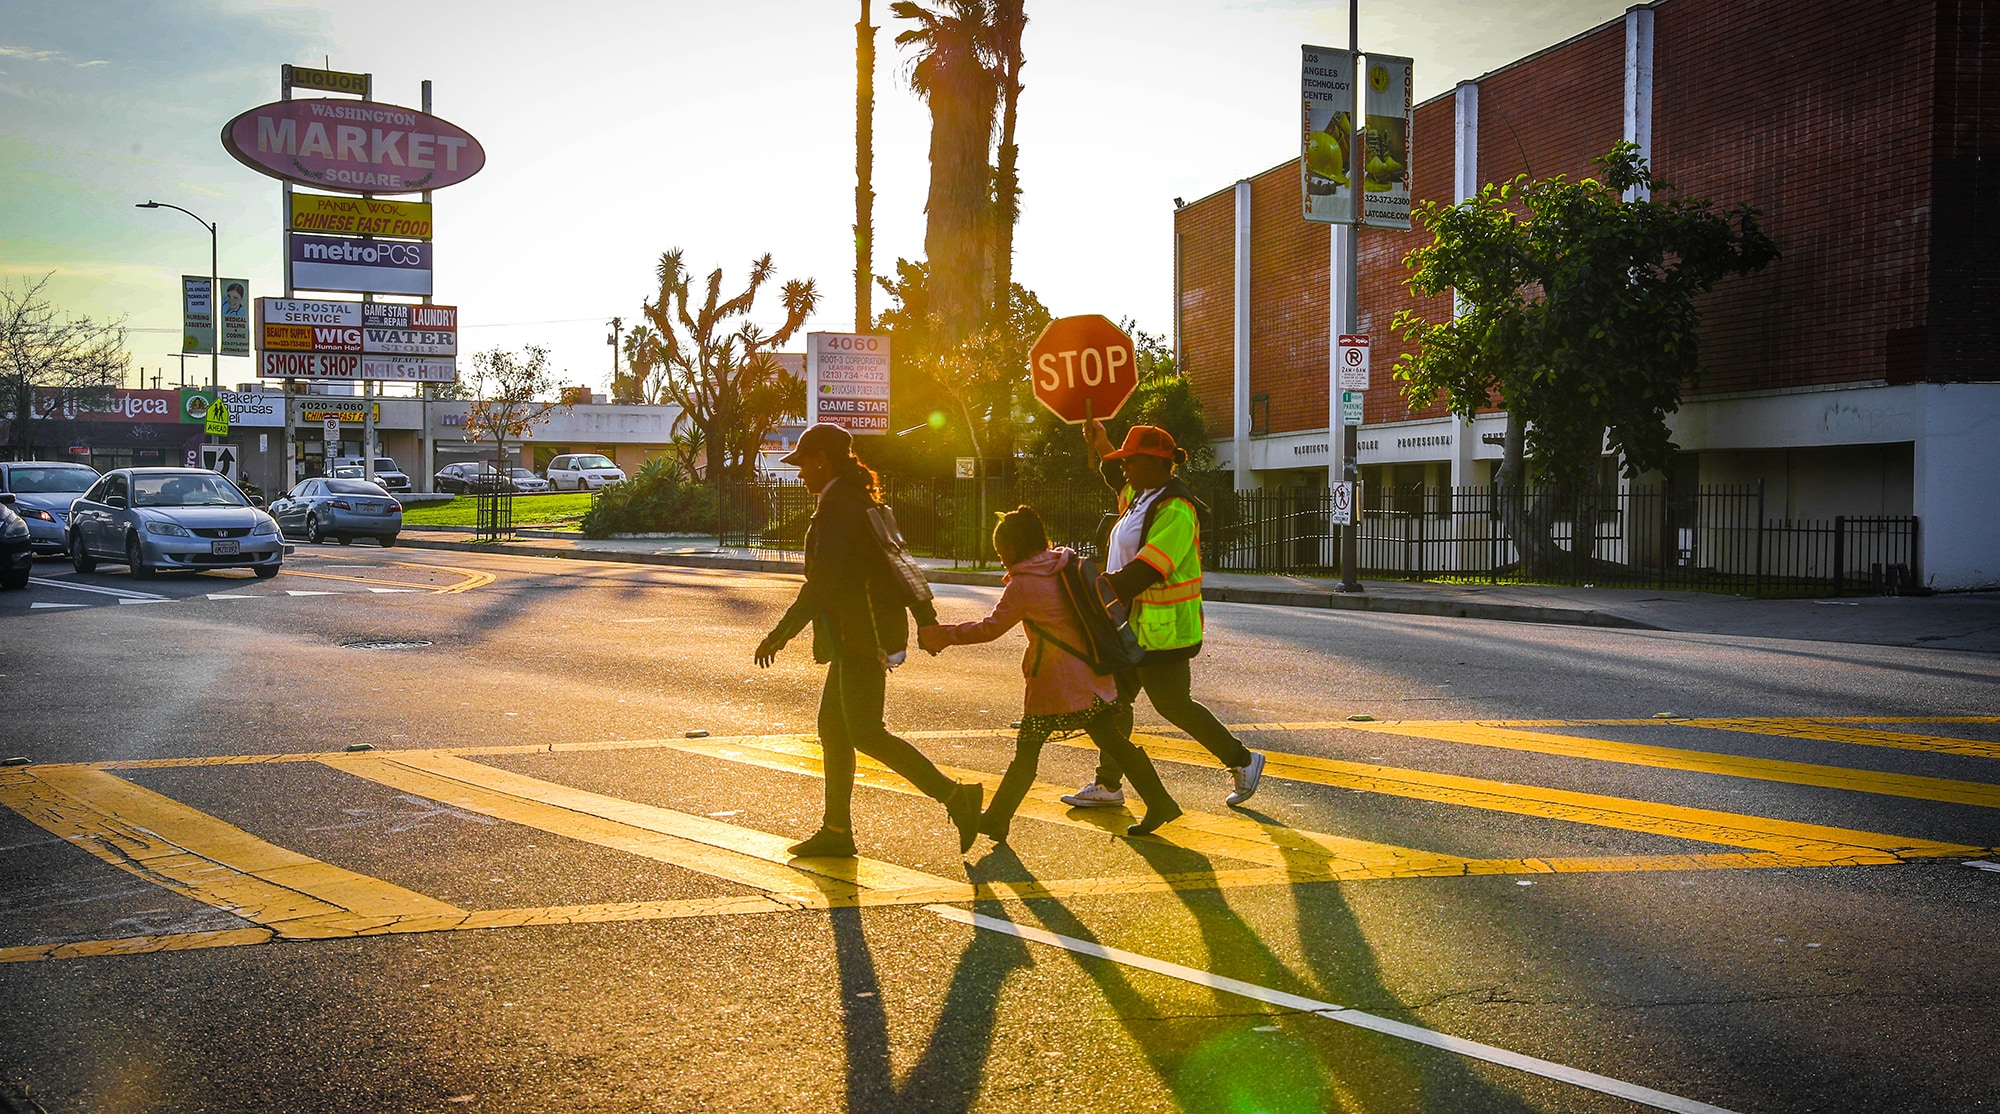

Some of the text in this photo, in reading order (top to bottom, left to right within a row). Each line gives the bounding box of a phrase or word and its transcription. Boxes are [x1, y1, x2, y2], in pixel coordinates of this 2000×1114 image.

[1304, 54, 1319, 63] LOS
[1304, 66, 1338, 78] ANGELES
[295, 70, 364, 90] LIQUOR
[1304, 78, 1350, 91] TECHNOLOGY
[1303, 90, 1333, 101] CENTER
[310, 103, 416, 127] WASHINGTON
[1403, 66, 1411, 192] CONSTRUCTION
[257, 116, 468, 172] MARKET
[1304, 101, 1312, 214] ELECTRICIAN
[325, 168, 401, 187] SQUARE
[1364, 194, 1410, 206] 323-373-2300
[317, 200, 408, 217] PANDA WOK
[294, 212, 430, 236] CHINESE FAST FOOD
[304, 241, 420, 266] metroPCS
[275, 302, 351, 314] U.S. POSTAL
[364, 304, 408, 318] GAME STAR
[285, 312, 341, 323] SERVICE
[384, 317, 408, 327] REPAIR
[413, 308, 456, 327] LAUNDRY
[267, 327, 311, 339] BEAUTY SUPPLY
[314, 327, 361, 345] WIG
[366, 329, 455, 346] WATER
[381, 344, 439, 352] STORE
[828, 337, 878, 351] 4060
[266, 353, 358, 377] SMOKE SHOP
[845, 356, 887, 366] CORPORATION
[364, 363, 456, 380] NAILS & HAIR
[1038, 345, 1128, 391] STOP
[822, 371, 884, 381] (213) 734-4372
[221, 392, 265, 405] Bakery
[300, 402, 328, 410] 4020
[819, 400, 888, 412] GAME STAR
[229, 412, 240, 423] eli
[339, 412, 358, 420] FAST
[851, 417, 888, 428] REPAIR
[207, 424, 227, 433] AHEAD
[1294, 443, 1329, 455] WASHINGTO
[1358, 440, 1379, 451] QUARE
